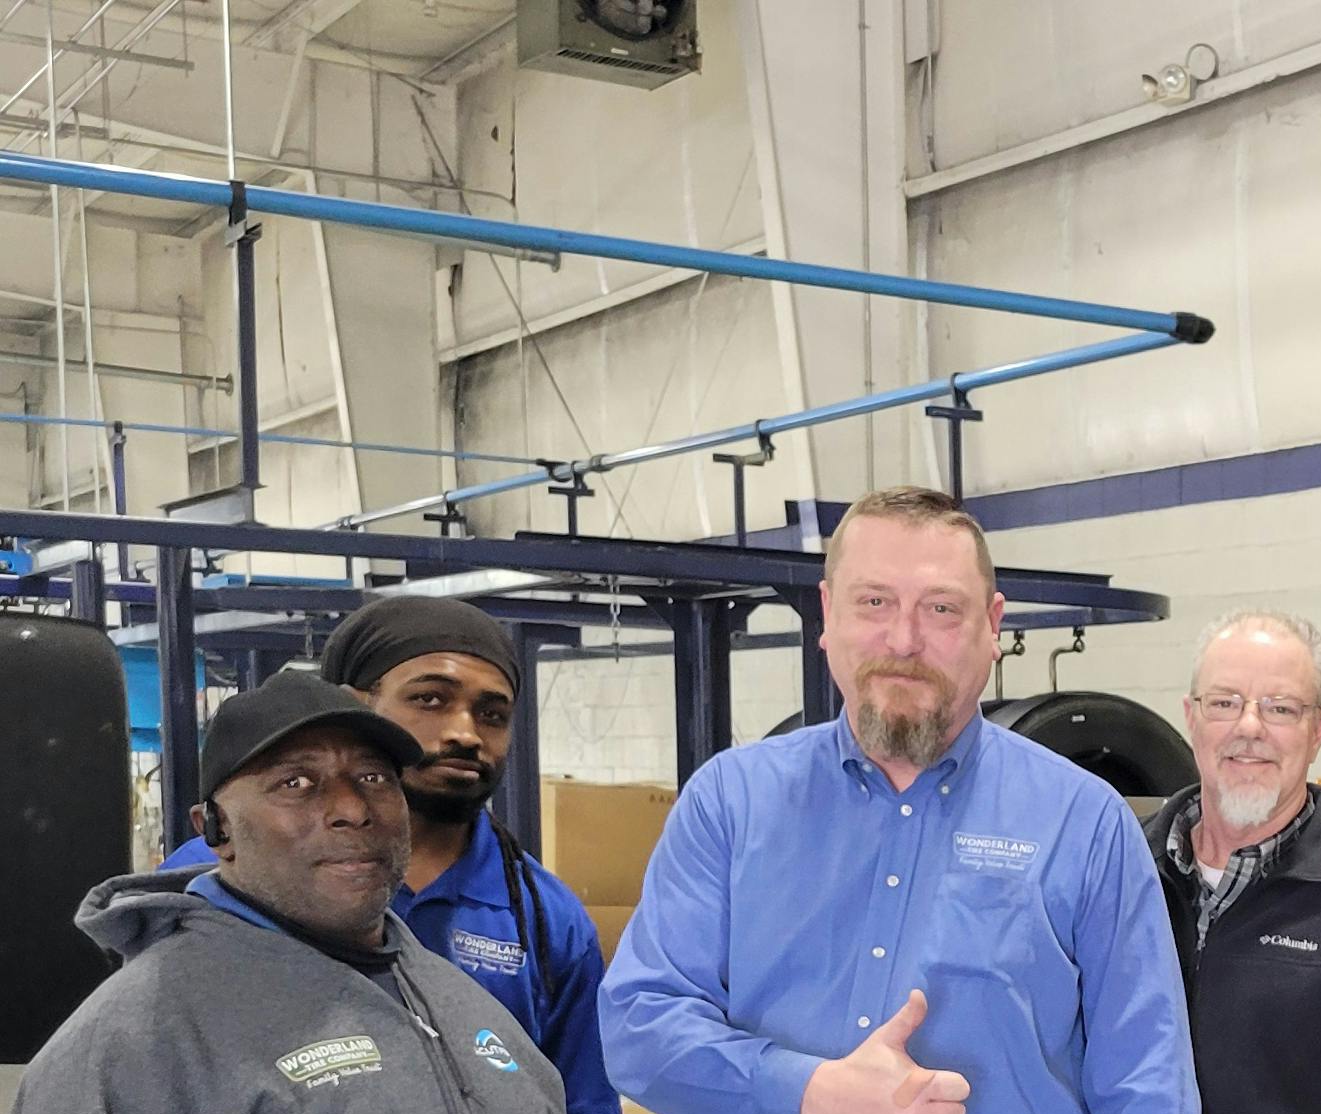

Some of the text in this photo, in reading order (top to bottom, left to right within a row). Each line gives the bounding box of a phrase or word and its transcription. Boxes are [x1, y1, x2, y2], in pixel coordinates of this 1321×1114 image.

[956, 835, 1035, 853] WONDERLAND
[1271, 934, 1319, 951] Columbia
[281, 1039, 373, 1072] WONDERLAND
[304, 1051, 368, 1072] TIRE COMPANY
